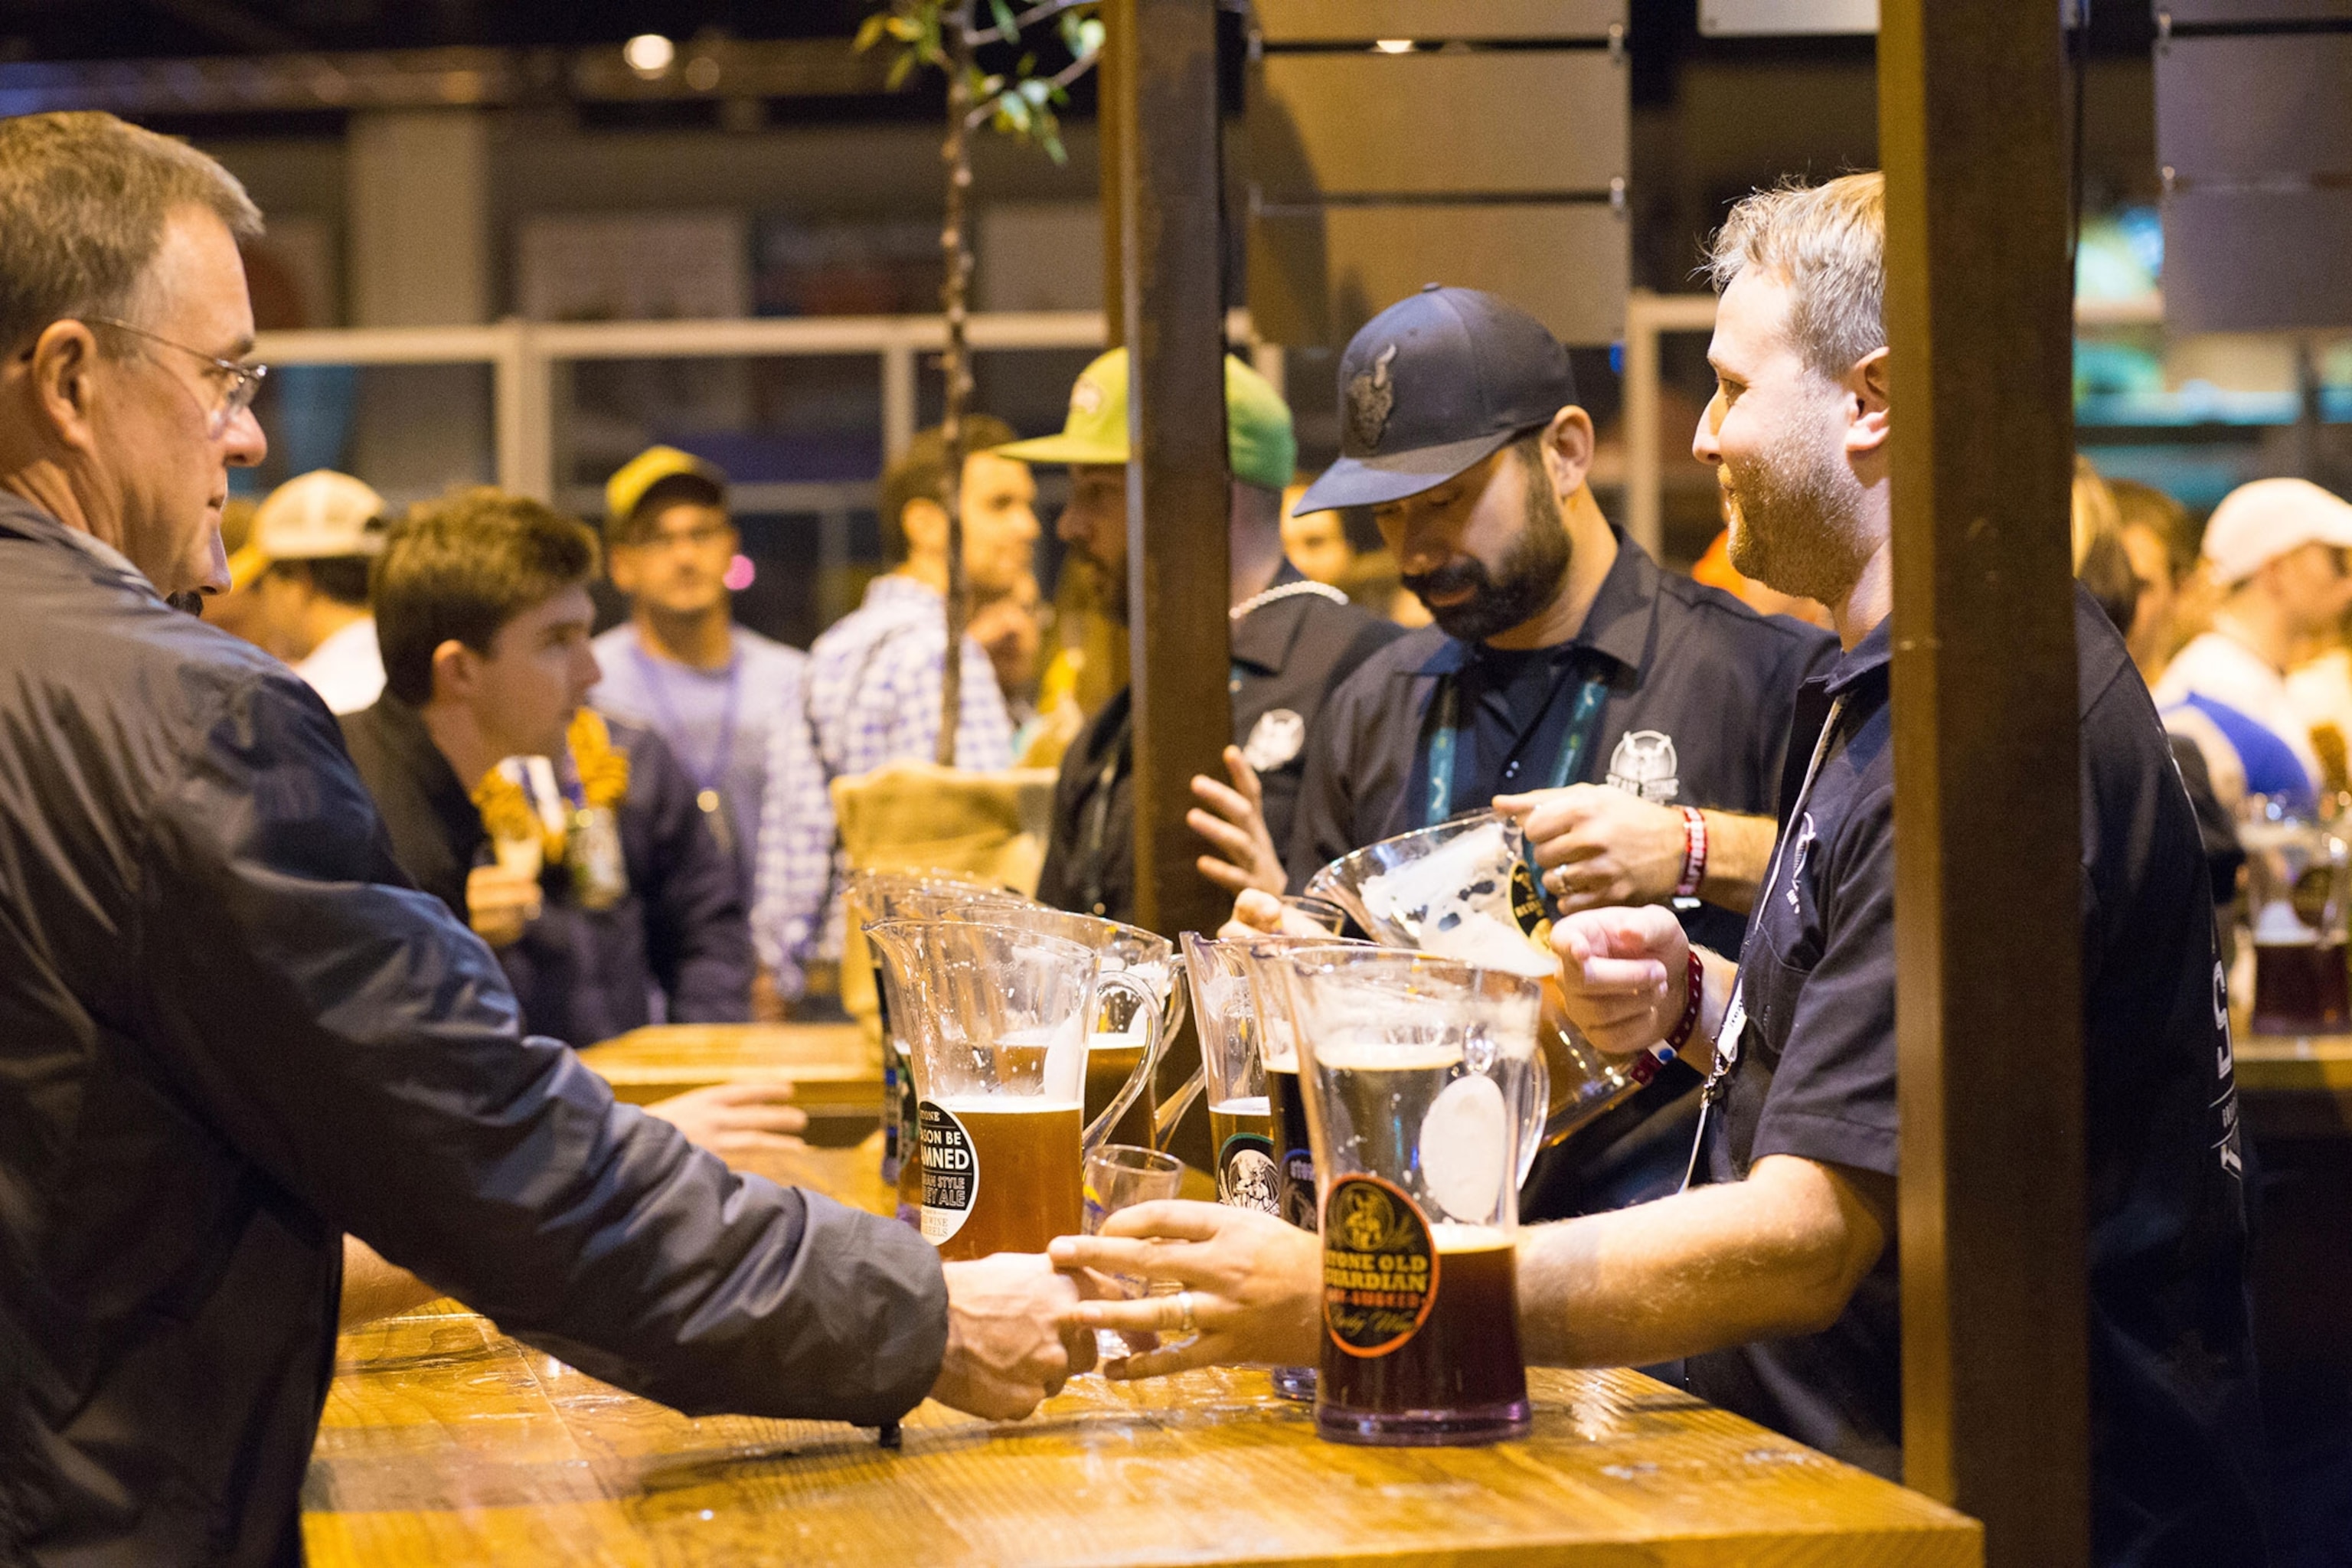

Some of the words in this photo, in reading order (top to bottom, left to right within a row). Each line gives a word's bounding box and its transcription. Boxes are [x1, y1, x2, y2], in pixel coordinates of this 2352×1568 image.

[946, 1131, 962, 1145] BE
[937, 1175, 965, 1190] STYLE
[939, 1188, 965, 1207] ALE
[1378, 1254, 1429, 1273] OLD
